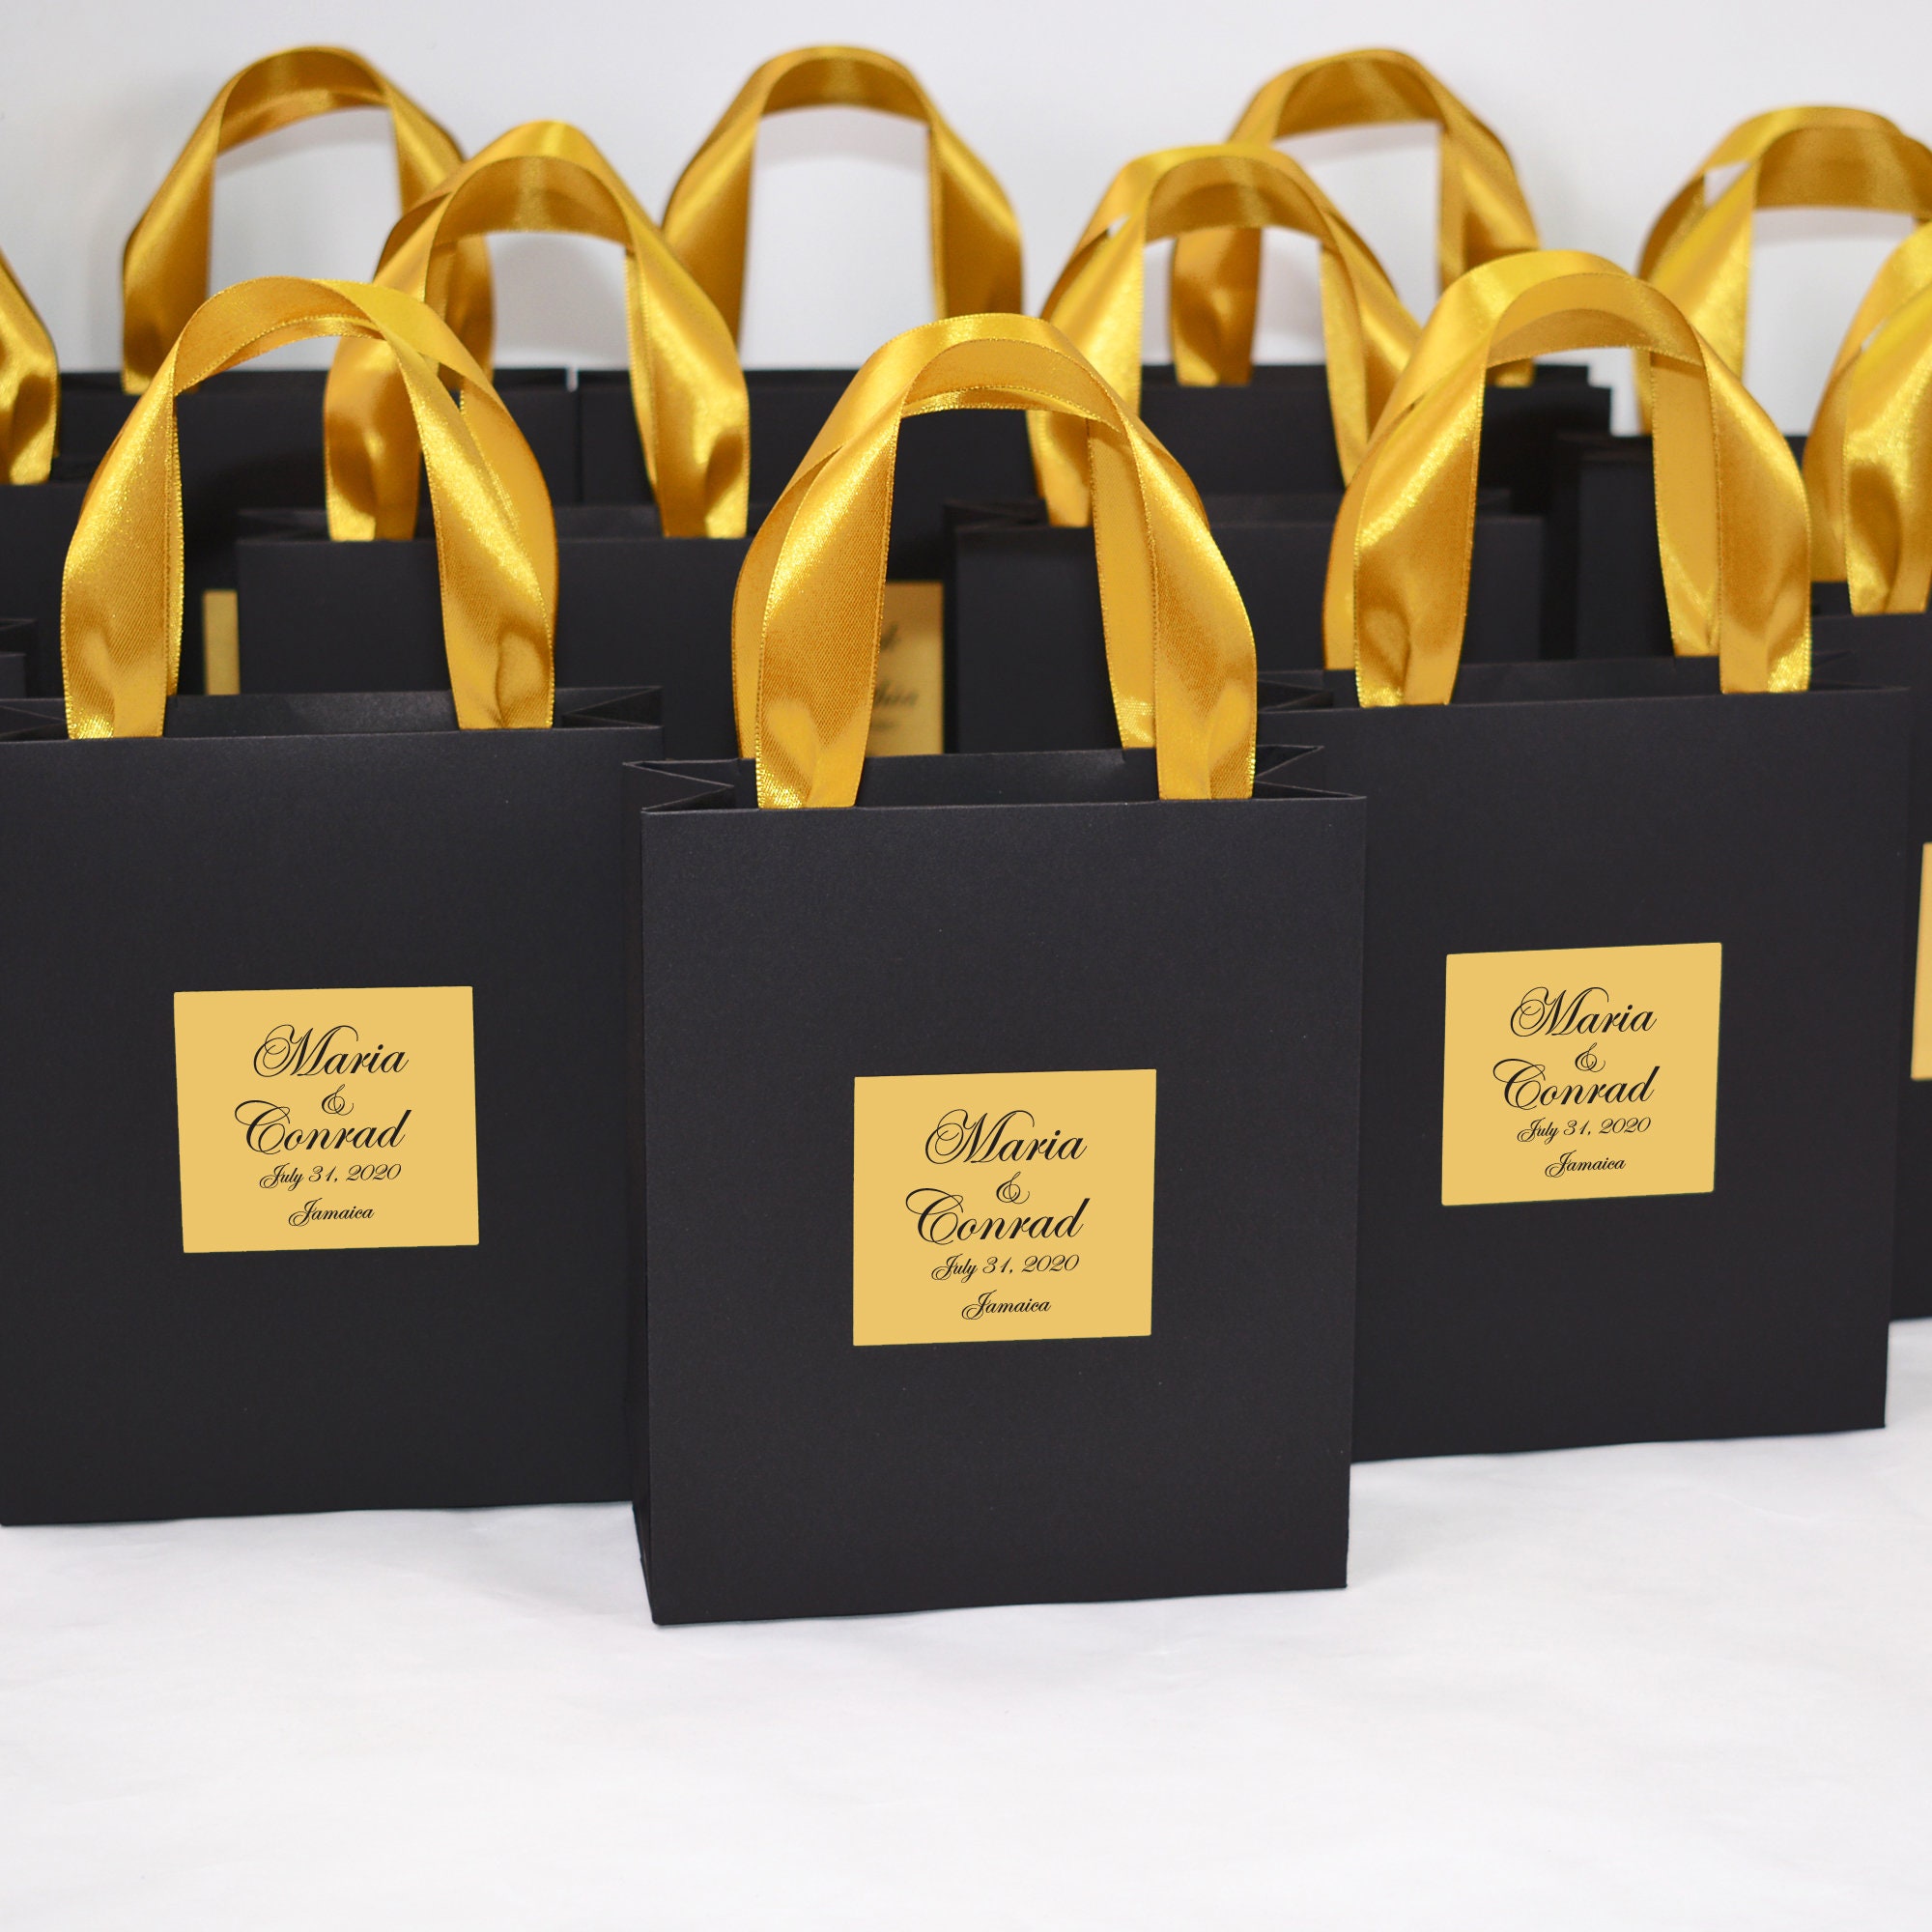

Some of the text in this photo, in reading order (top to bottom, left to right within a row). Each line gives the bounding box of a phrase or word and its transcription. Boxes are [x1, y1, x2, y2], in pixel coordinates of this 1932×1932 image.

[1509, 985, 1657, 1038] Maria
[252, 1024, 408, 1079] Maria
[1575, 1041, 1606, 1073] &
[321, 1084, 355, 1117] &
[1492, 1057, 1661, 1111] Conrad
[234, 1098, 412, 1156] Conrad
[924, 1108, 1089, 1166] Maria
[1516, 1117, 1653, 1146] July 31, 2020
[258, 1162, 403, 1192] July 31, 2020
[1543, 1151, 1627, 1179] Jamaica
[996, 1170, 1031, 1206] &
[287, 1198, 375, 1229] Jamaica
[904, 1186, 1092, 1247] Conrad
[930, 1254, 1081, 1284] July 31, 2020
[960, 1289, 1052, 1321] Jamaica
